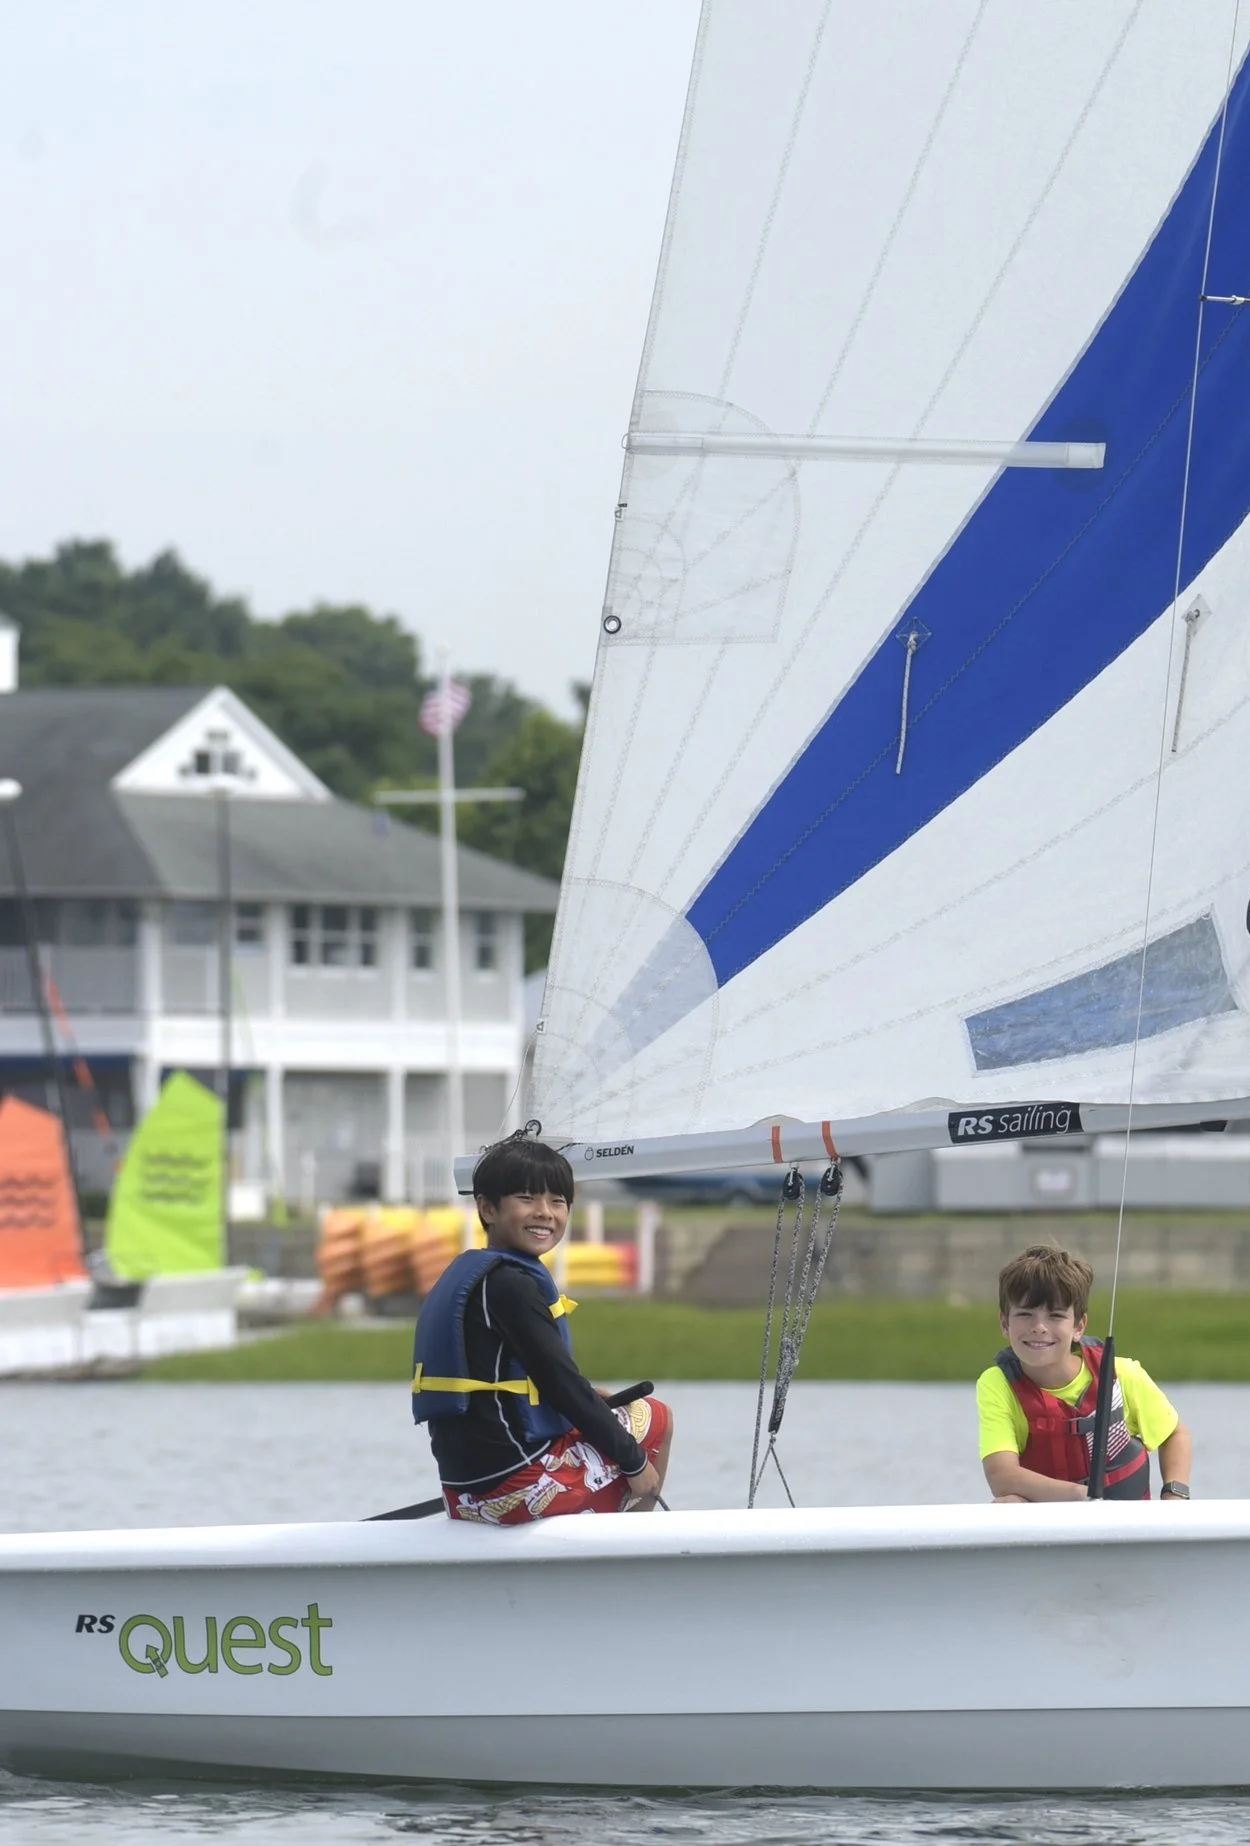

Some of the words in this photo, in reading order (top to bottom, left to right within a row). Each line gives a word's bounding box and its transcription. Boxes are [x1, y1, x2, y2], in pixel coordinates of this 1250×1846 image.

[957, 1115, 994, 1136] RS
[998, 1105, 1072, 1134] sailing
[595, 1144, 635, 1158] SELDÉN
[75, 1614, 116, 1634] RS
